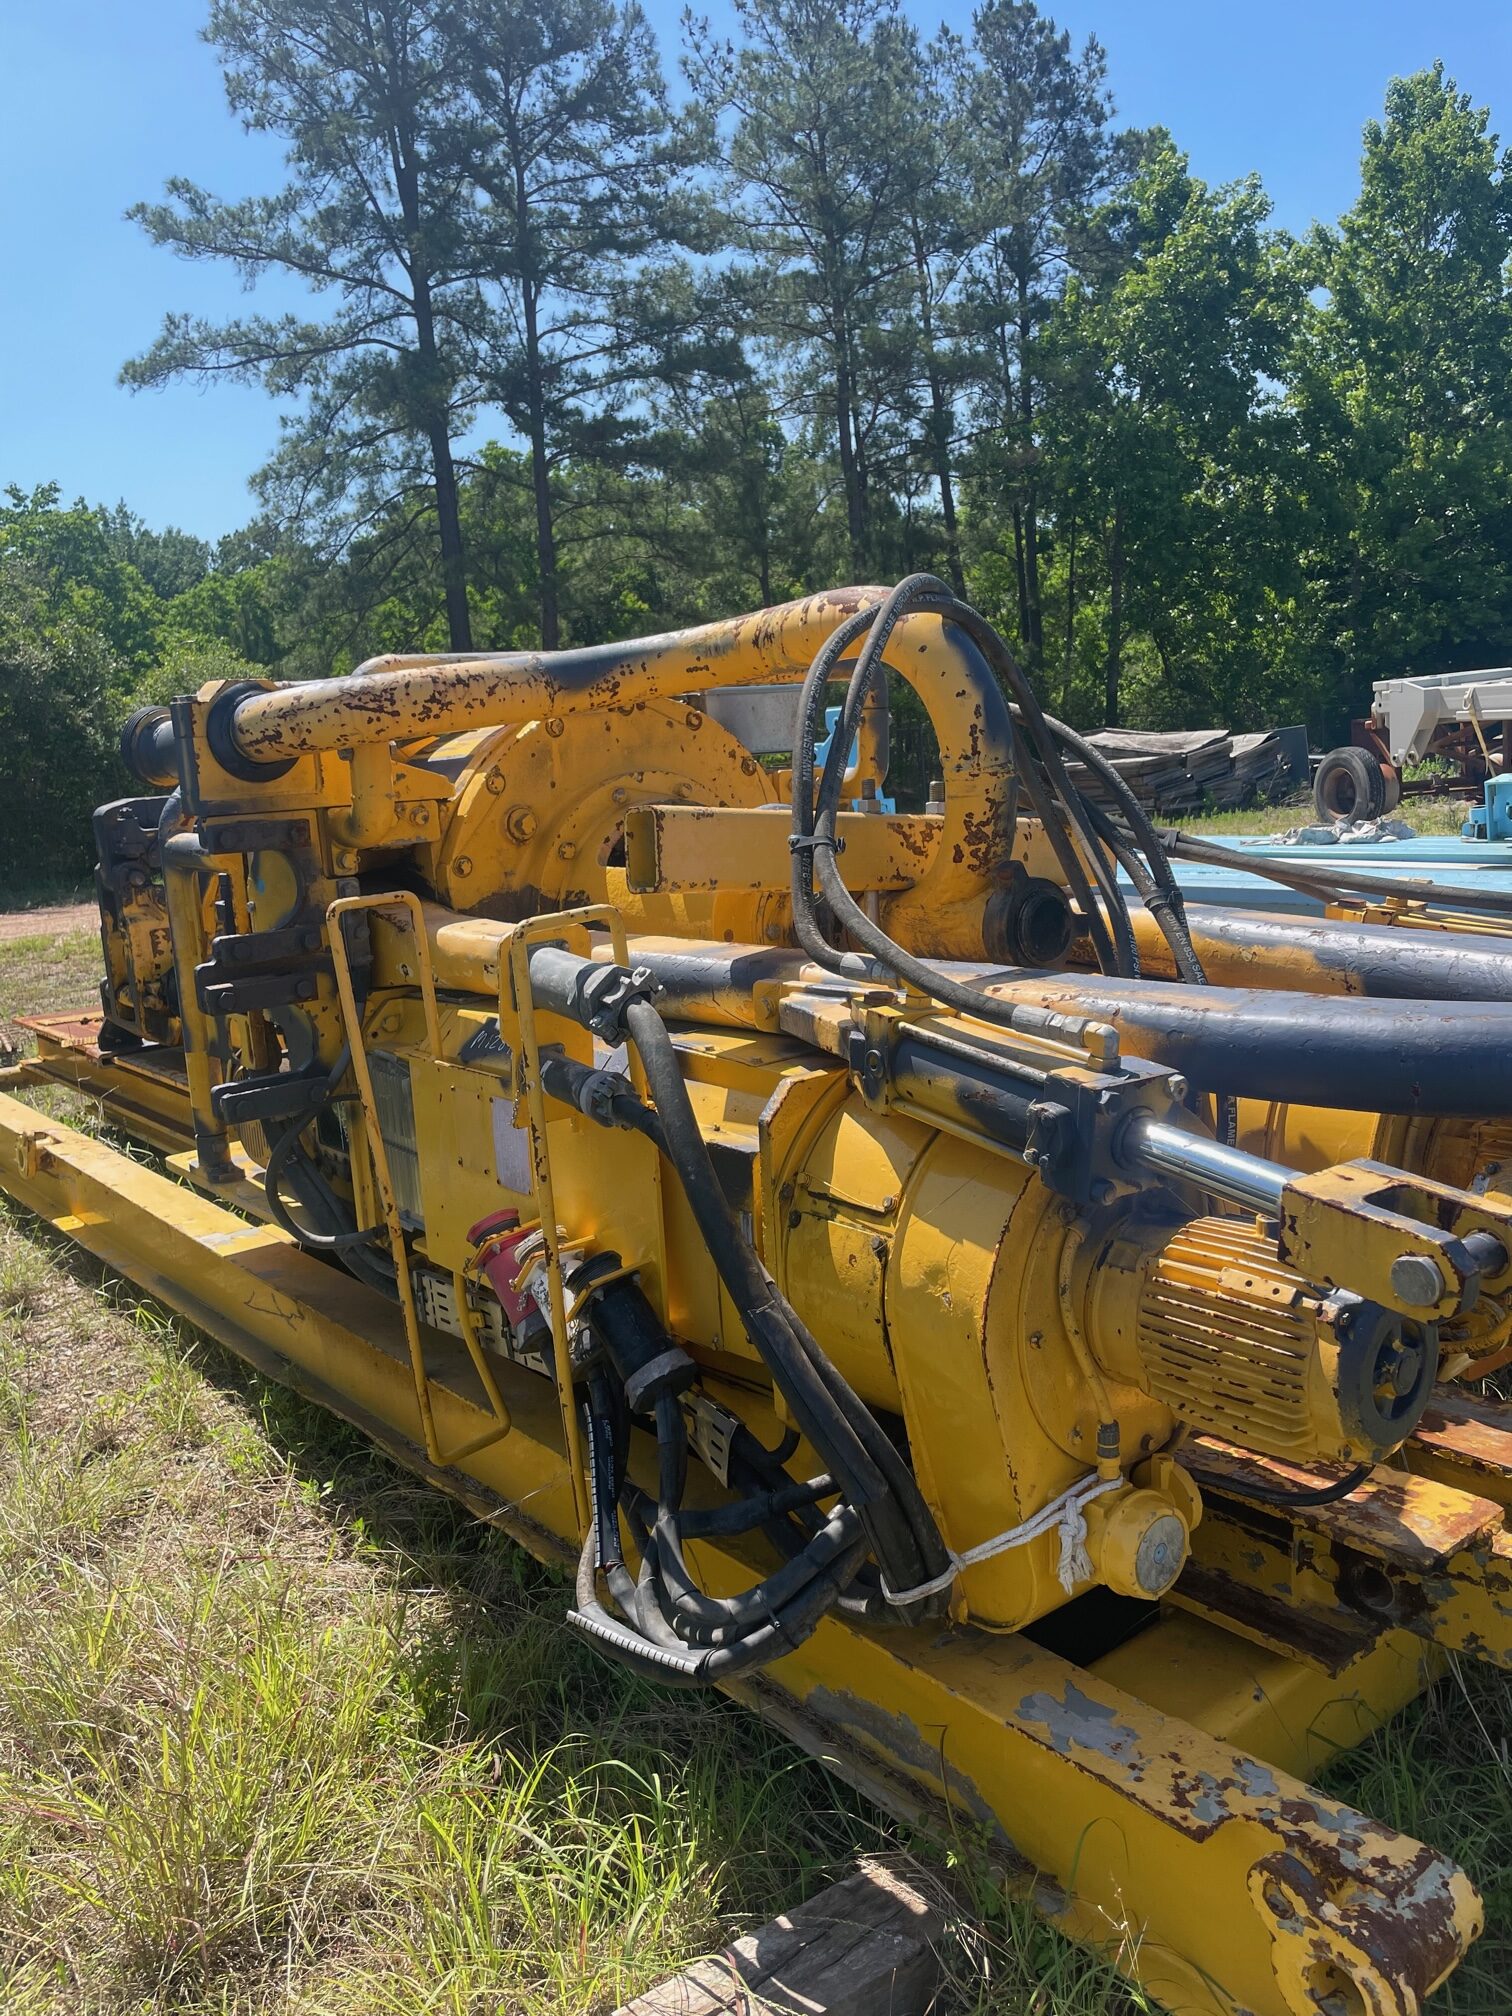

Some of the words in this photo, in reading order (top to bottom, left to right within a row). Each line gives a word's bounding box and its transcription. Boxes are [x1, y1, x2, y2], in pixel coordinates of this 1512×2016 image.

[883, 612, 897, 632] SAE
[1182, 944, 1196, 963] 853
[1190, 962, 1207, 985] SAE
[1227, 1107, 1236, 1146] FLAME
